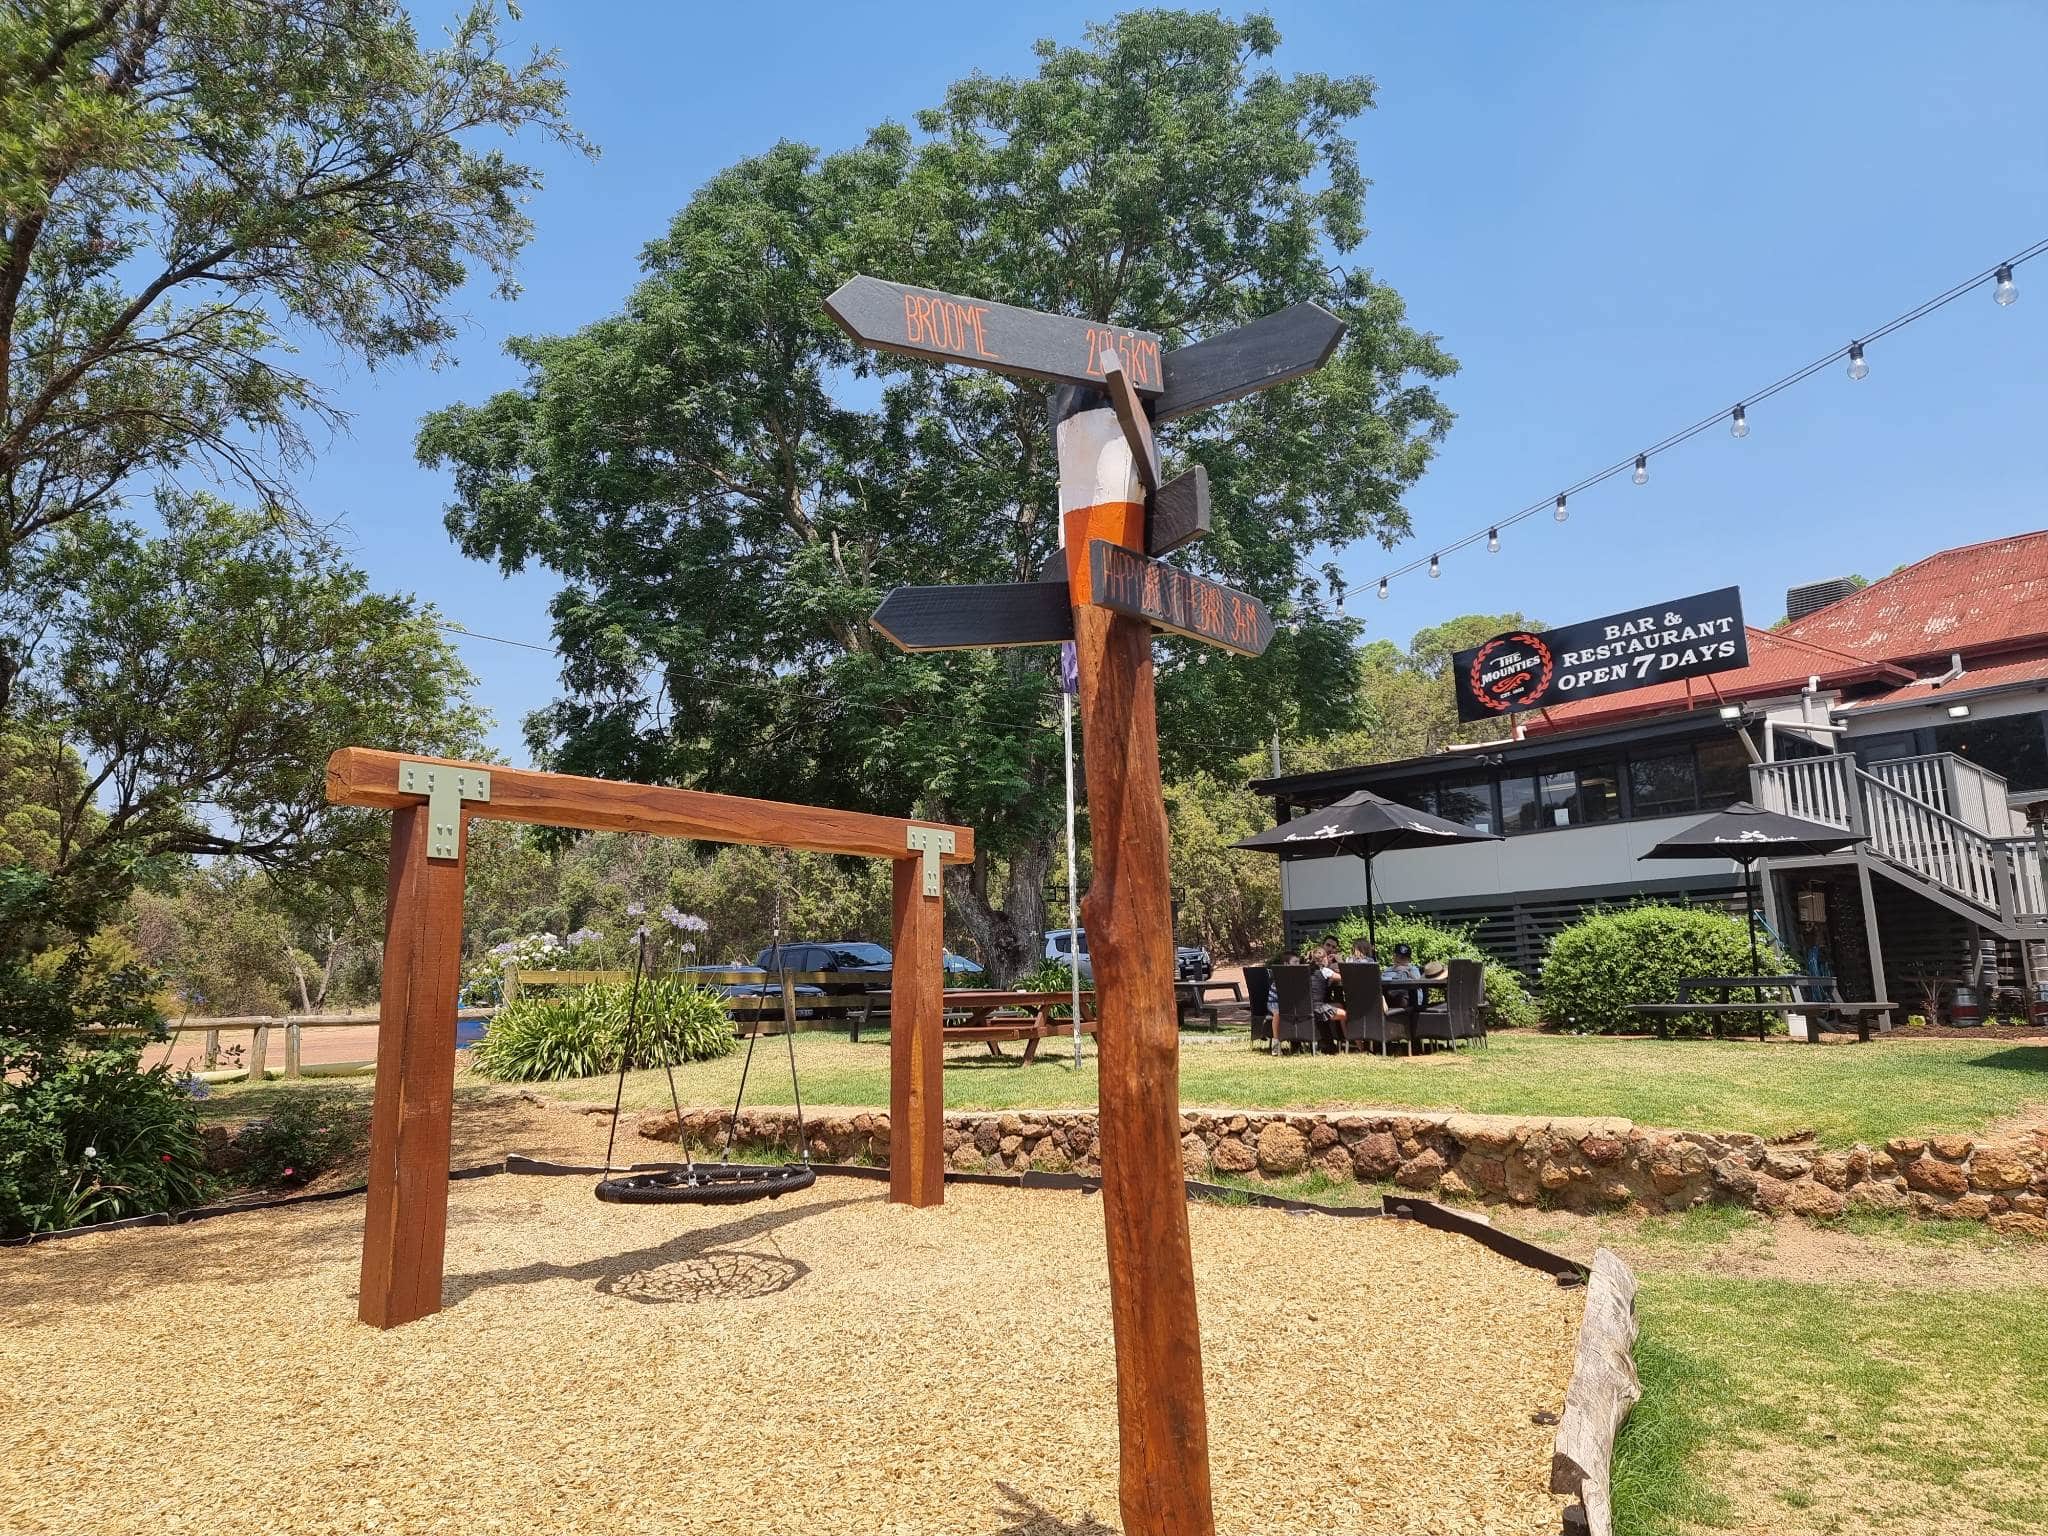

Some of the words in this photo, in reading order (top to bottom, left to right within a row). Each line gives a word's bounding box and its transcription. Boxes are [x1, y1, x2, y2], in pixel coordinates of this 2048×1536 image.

[905, 294, 999, 358] BROOME
[1562, 616, 1734, 668] RESTAURANT
[1604, 616, 1656, 641] BAR
[1663, 611, 1683, 626] &
[1481, 655, 1541, 687] MOUNTIES
[1490, 652, 1521, 667] THE
[1557, 662, 1628, 691] OPEN
[1632, 653, 1656, 679] 7
[1659, 640, 1736, 671] DAYS
